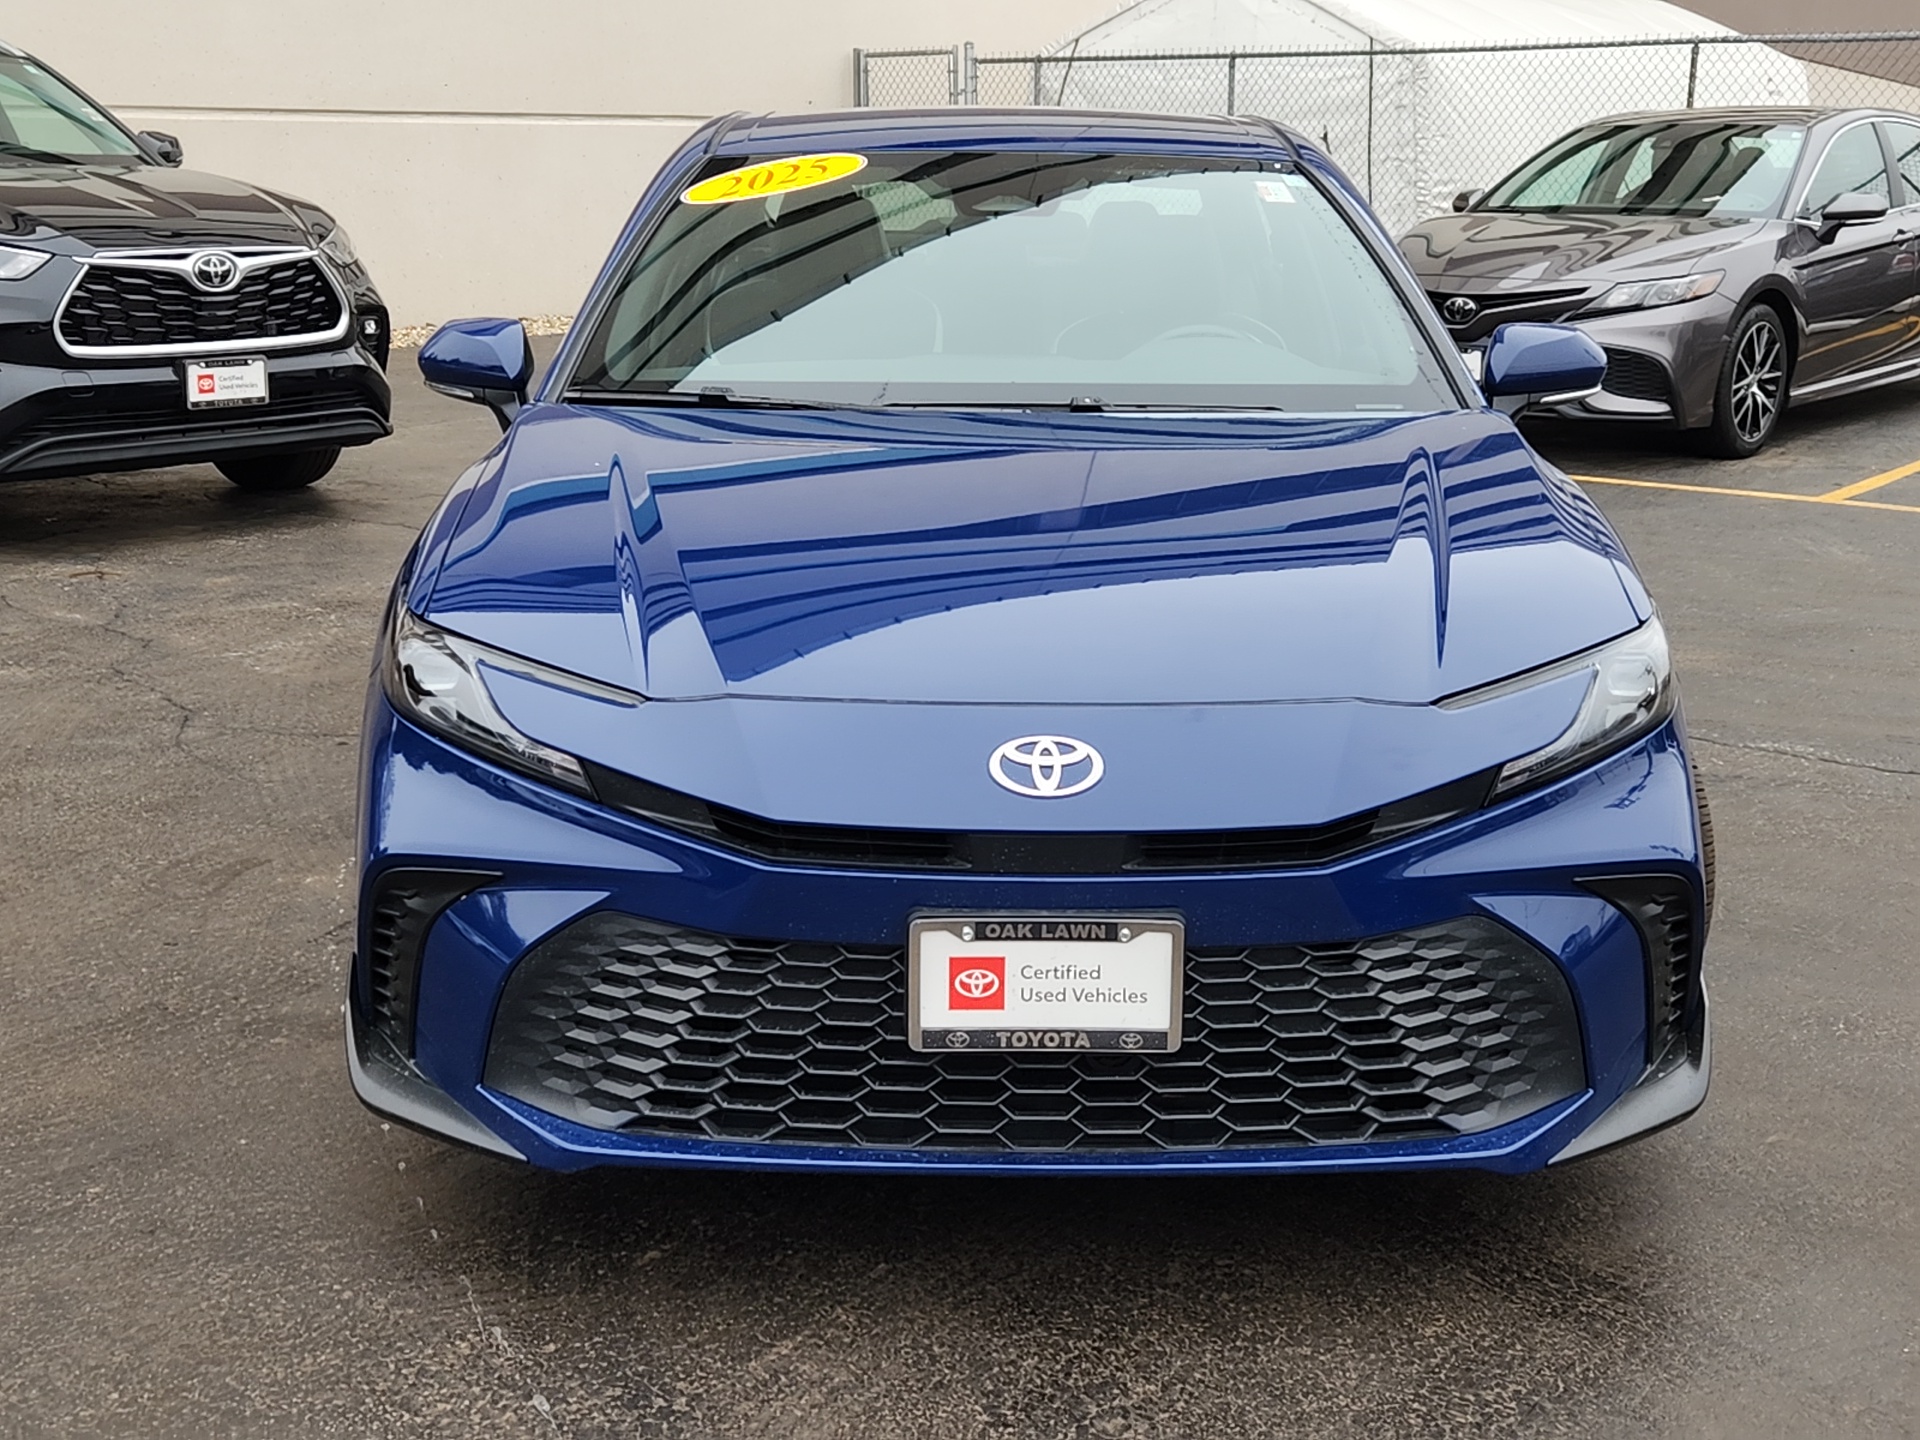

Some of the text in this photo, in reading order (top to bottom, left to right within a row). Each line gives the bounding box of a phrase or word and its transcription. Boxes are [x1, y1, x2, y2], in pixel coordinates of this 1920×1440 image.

[717, 158, 831, 199] 2025
[985, 924, 1107, 940] OAK LAWN
[1020, 964, 1101, 980] Certified
[1020, 987, 1149, 1004] Used Vehicles
[997, 1031, 1091, 1049] TOYOTA
